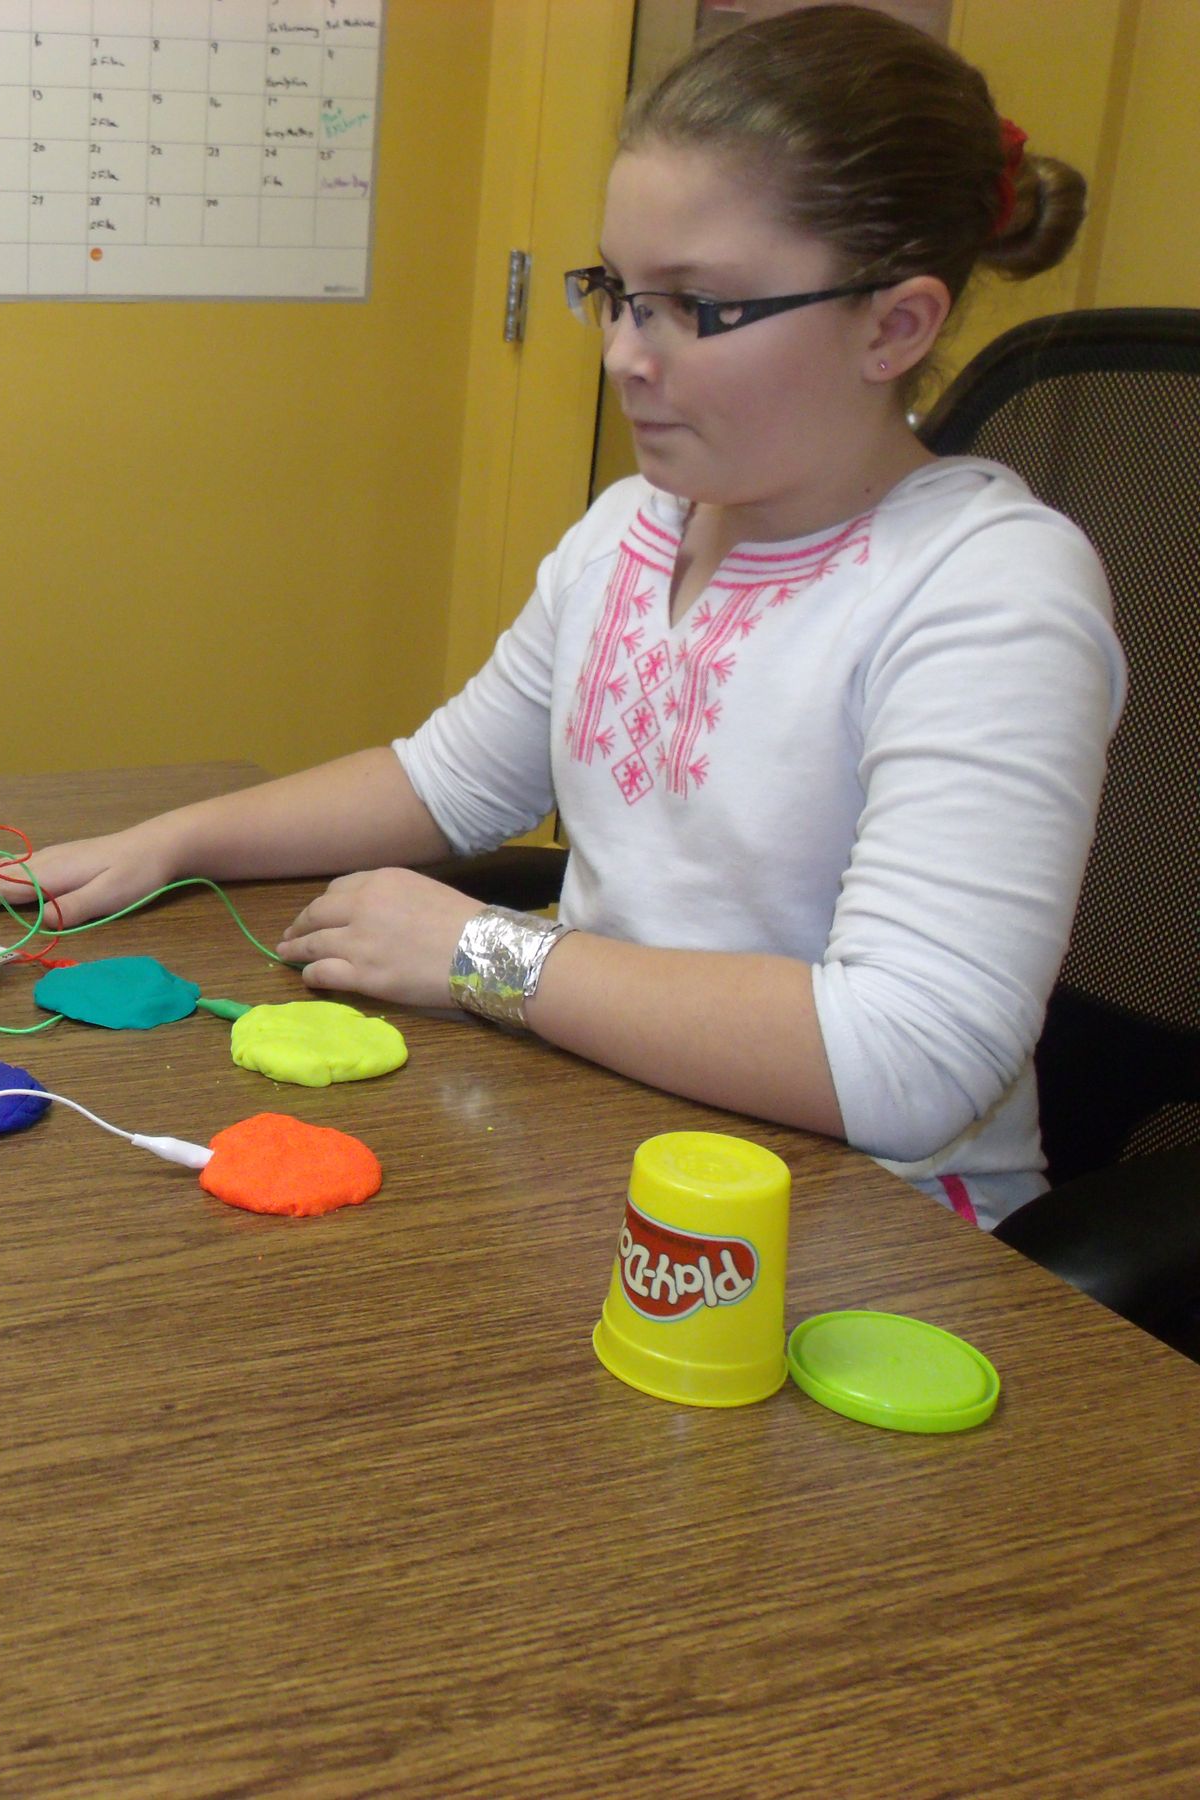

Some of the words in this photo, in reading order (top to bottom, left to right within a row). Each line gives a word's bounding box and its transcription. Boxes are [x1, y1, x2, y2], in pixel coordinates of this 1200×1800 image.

[34, 33, 43, 47] 6
[92, 38, 99, 48] 7
[153, 39, 161, 52] 8
[211, 42, 219, 54] 9
[32, 89, 44, 101] 13
[32, 142, 46, 153] 20
[618, 1217, 753, 1309] Play-Do
